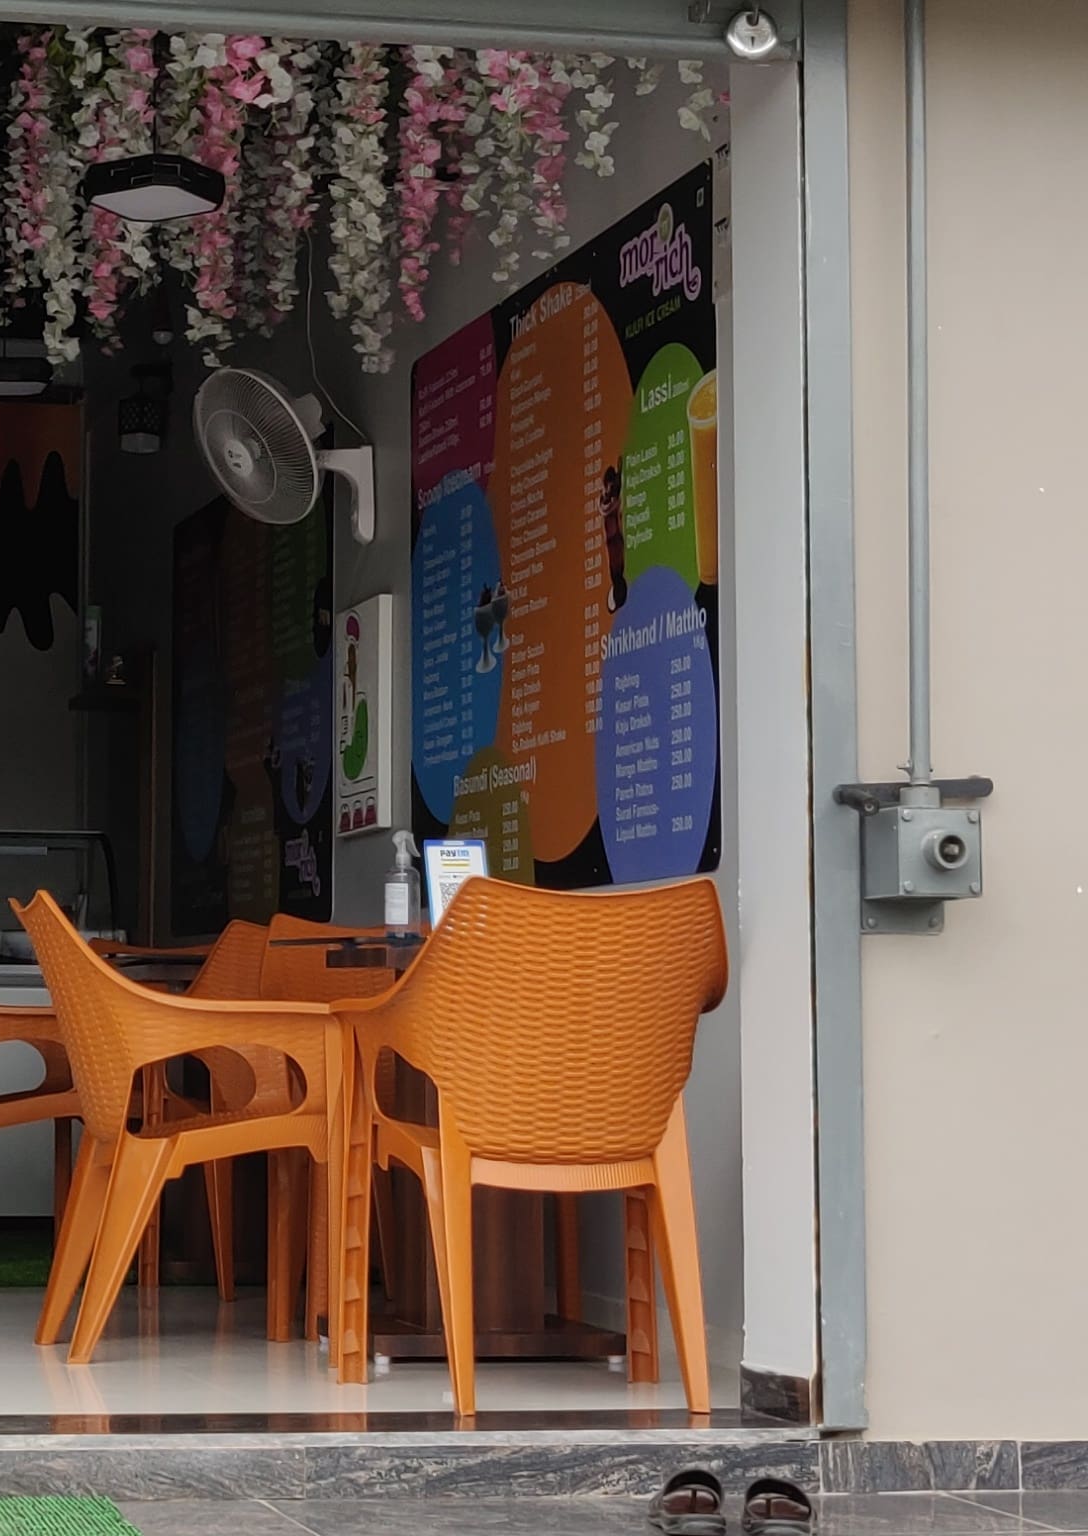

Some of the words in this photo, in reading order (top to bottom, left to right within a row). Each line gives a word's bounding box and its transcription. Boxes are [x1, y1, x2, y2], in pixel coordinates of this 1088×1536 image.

[509, 303, 537, 342] Thick
[539, 283, 573, 323] Shake
[600, 617, 657, 660] Shrikhand
[665, 605, 707, 640] Mattho
